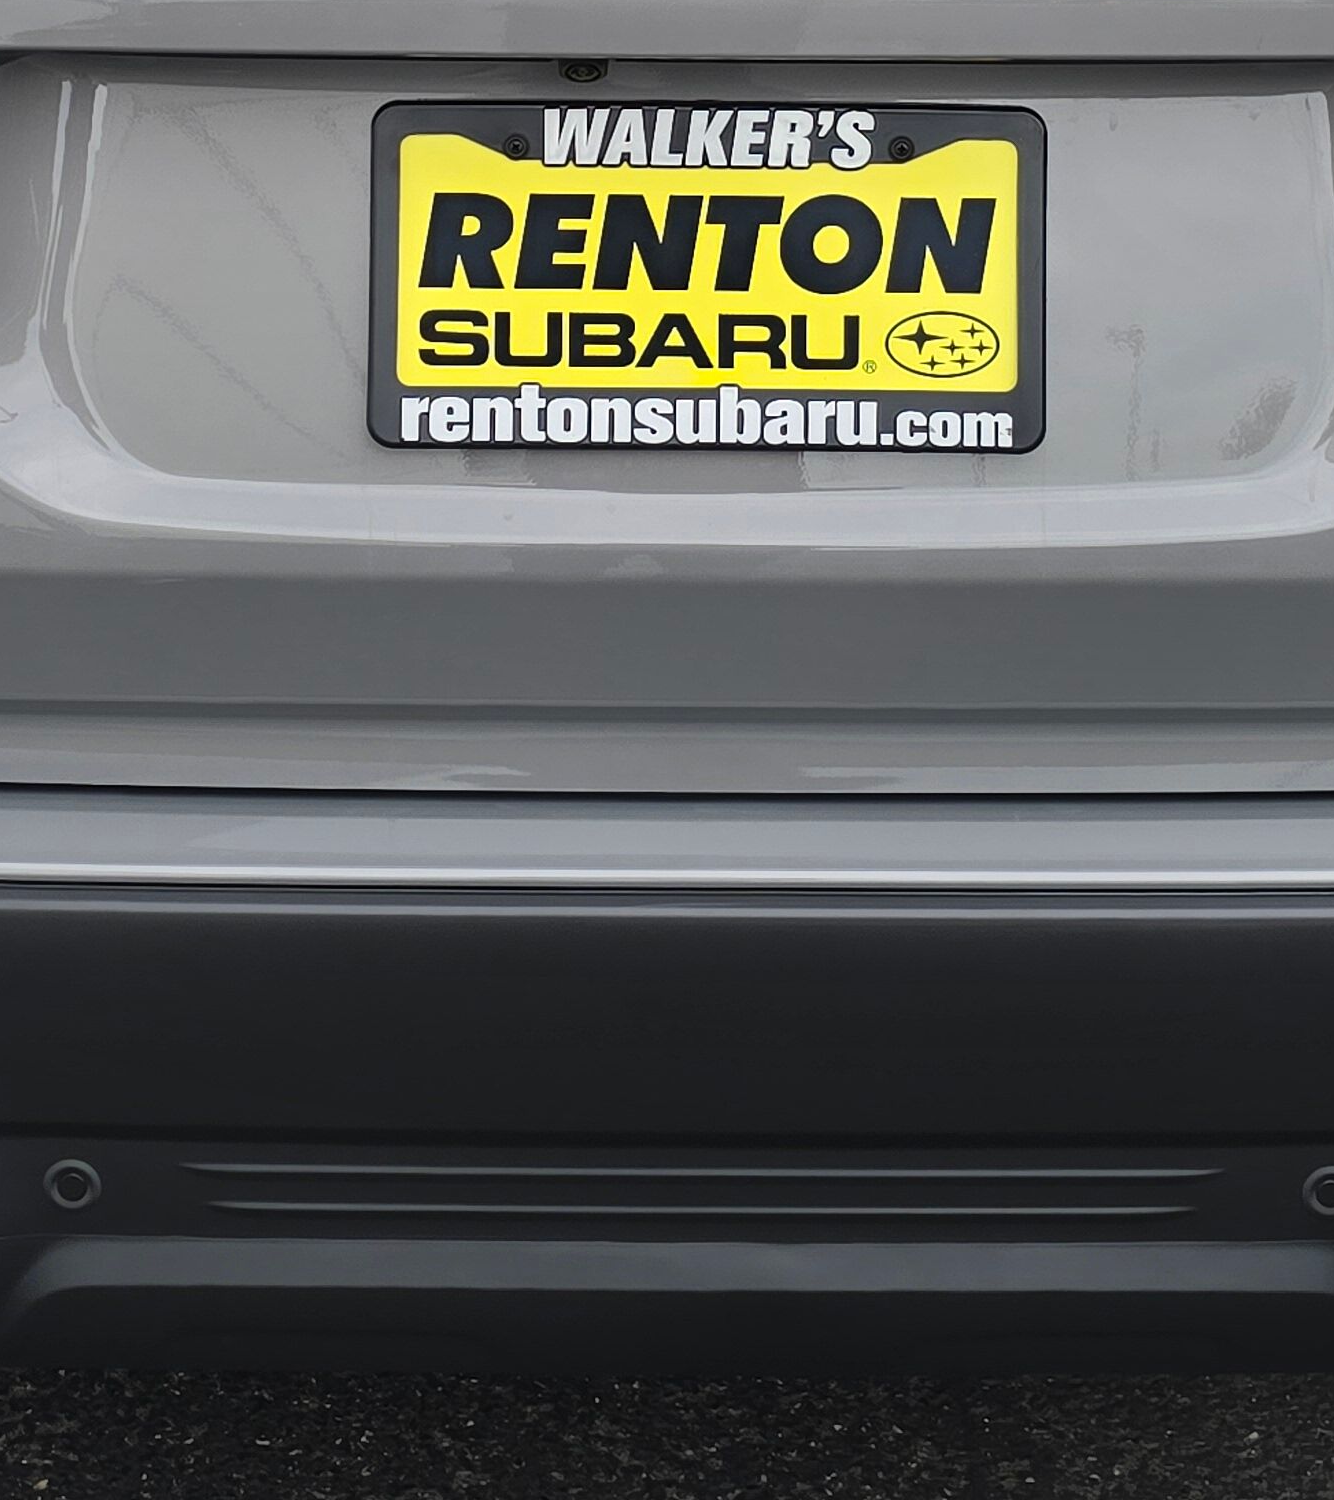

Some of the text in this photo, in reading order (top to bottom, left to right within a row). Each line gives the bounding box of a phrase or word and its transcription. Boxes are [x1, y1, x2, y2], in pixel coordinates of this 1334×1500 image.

[542, 108, 875, 169] WALKER'S
[418, 192, 996, 294] RENTON
[400, 384, 1013, 448] rentonsubaru.com
